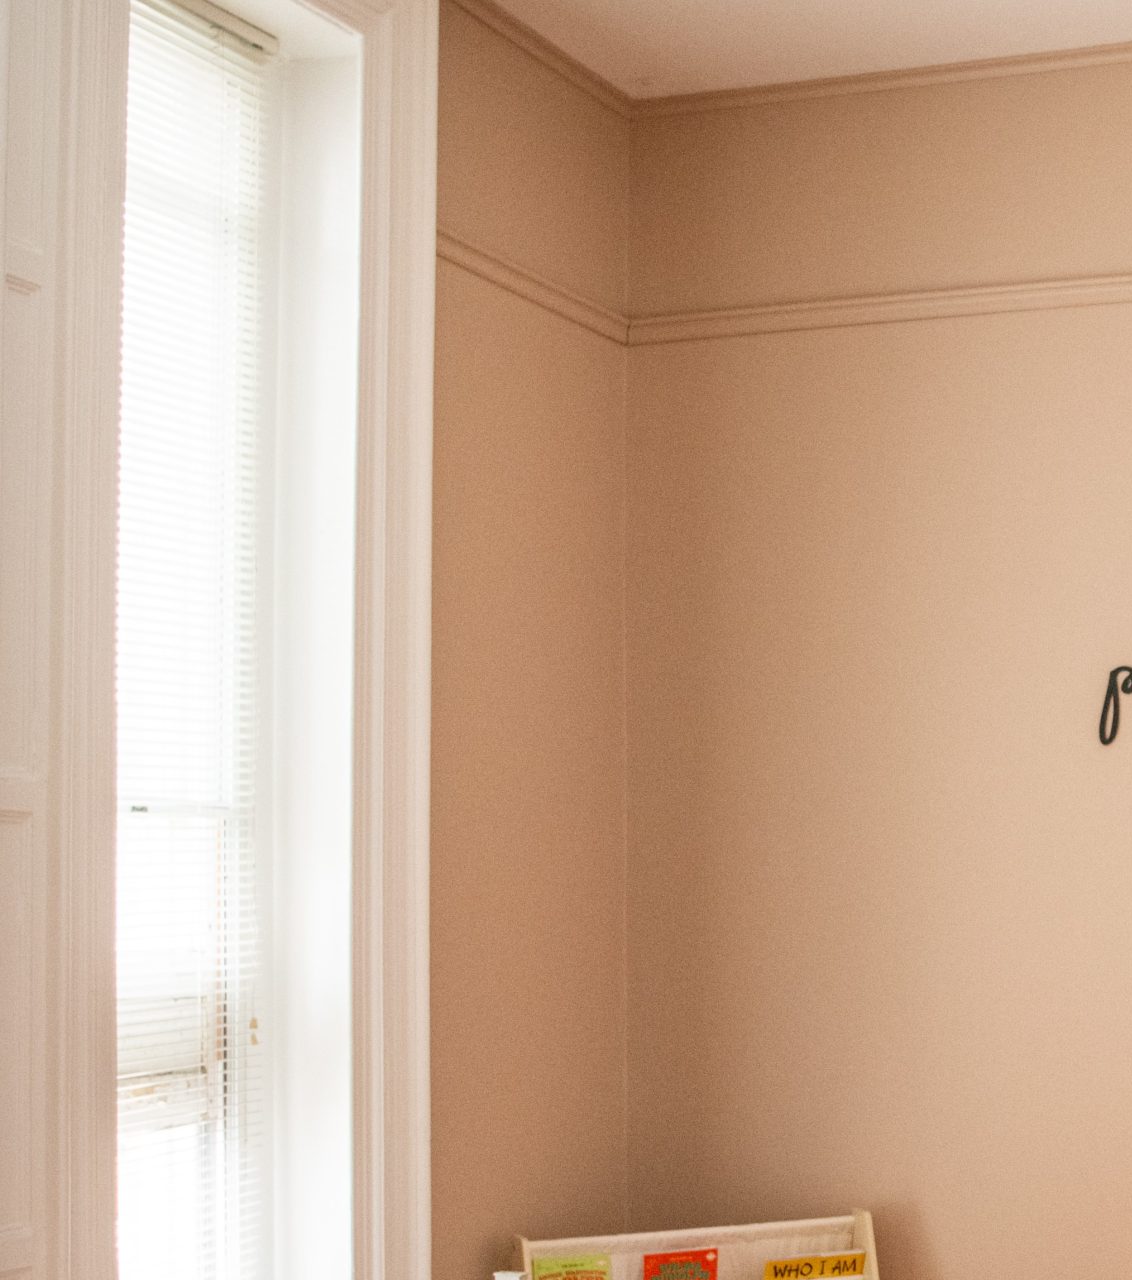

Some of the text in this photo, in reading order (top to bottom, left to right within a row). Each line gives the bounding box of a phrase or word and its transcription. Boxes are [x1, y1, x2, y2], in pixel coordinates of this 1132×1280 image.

[773, 1258, 857, 1279] WHO I AM
